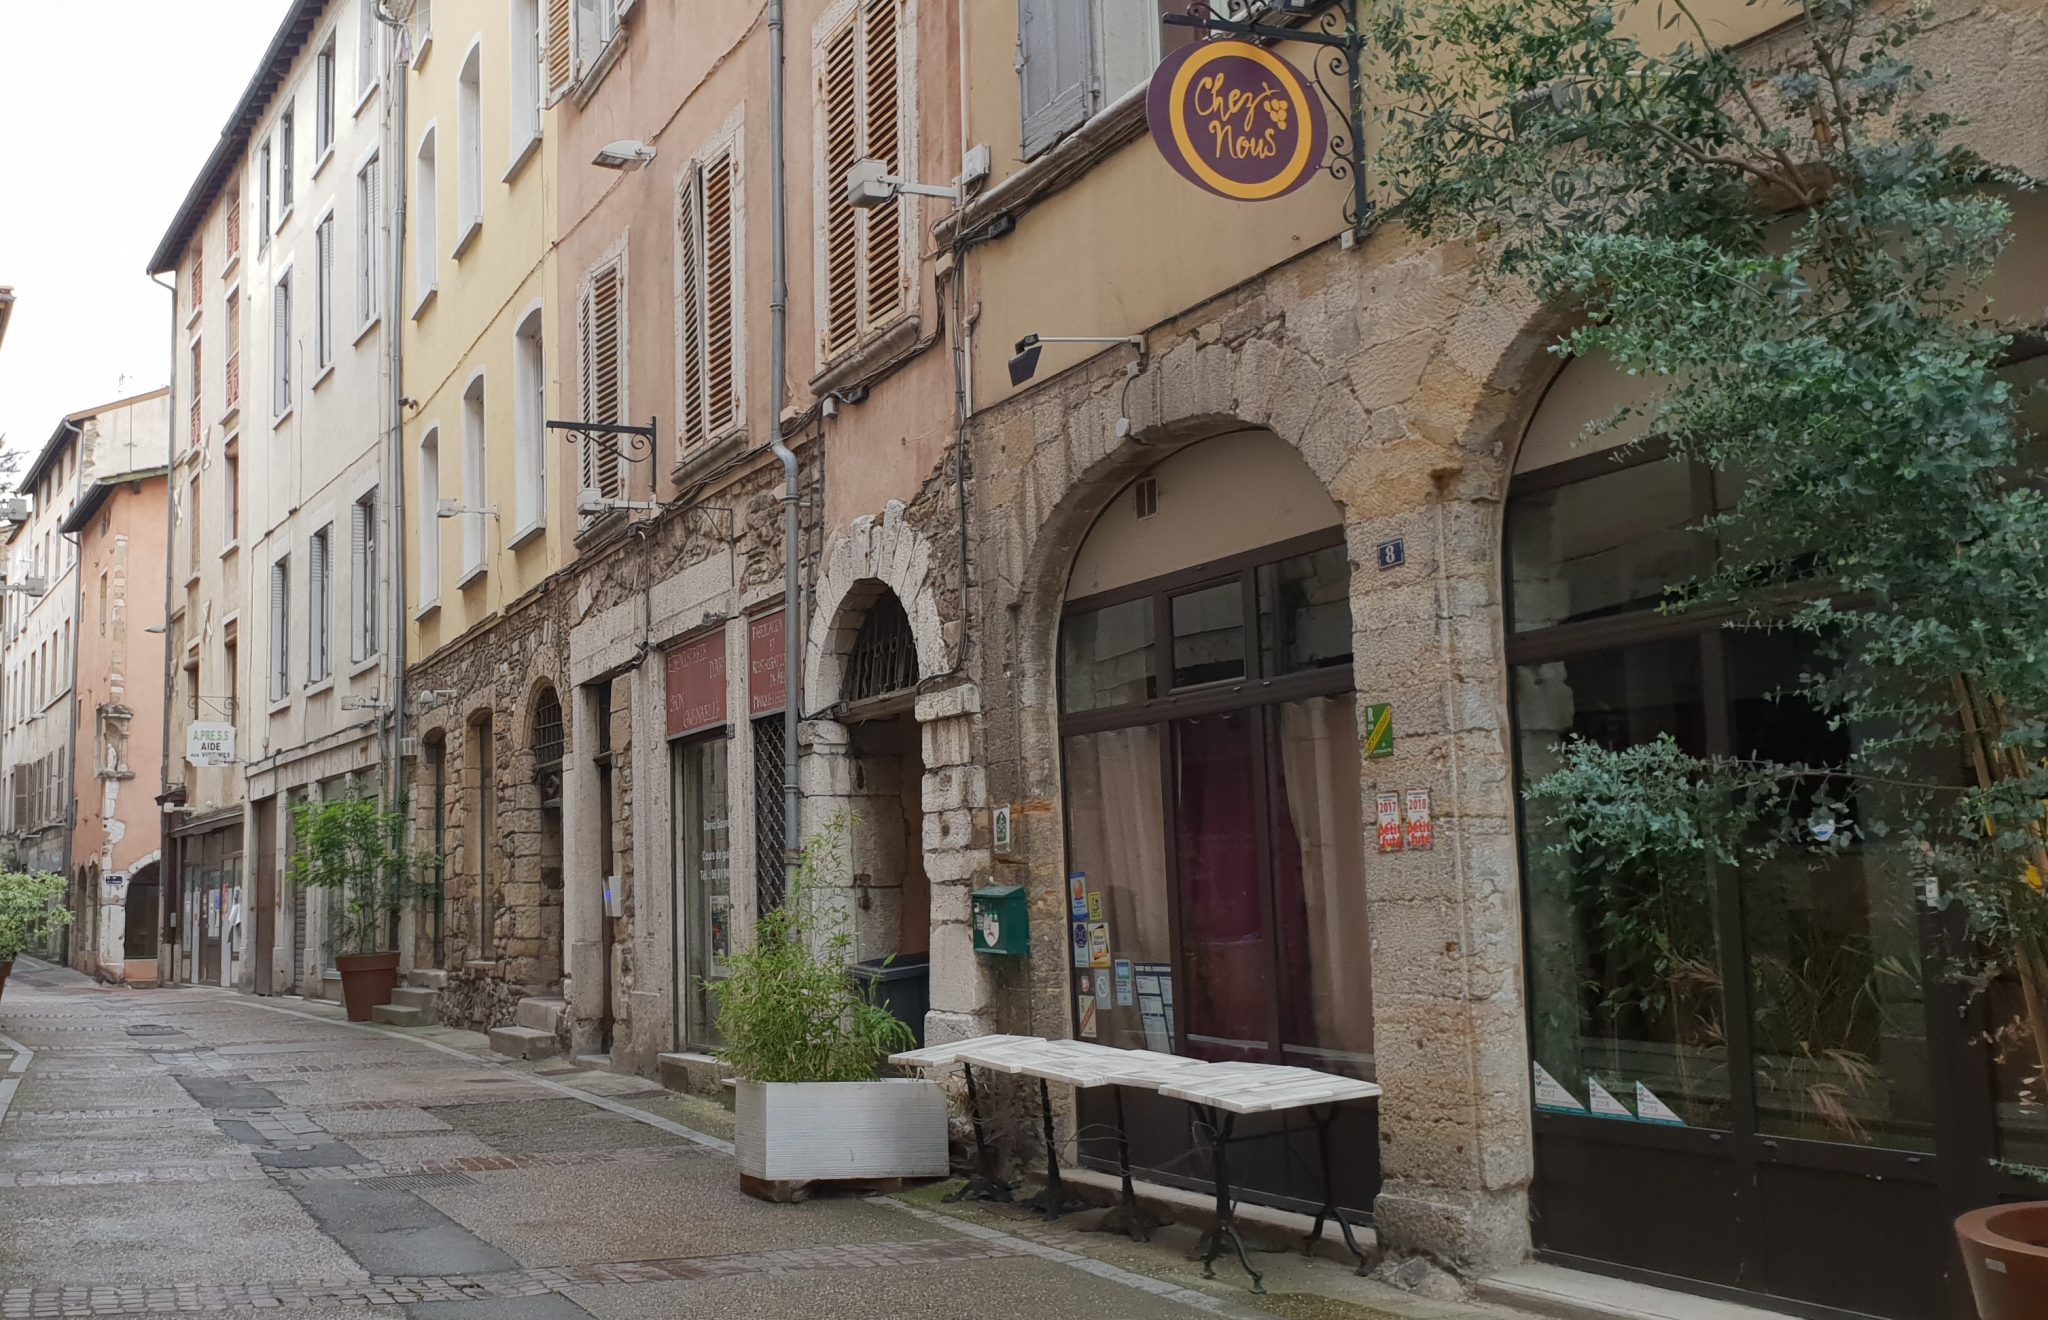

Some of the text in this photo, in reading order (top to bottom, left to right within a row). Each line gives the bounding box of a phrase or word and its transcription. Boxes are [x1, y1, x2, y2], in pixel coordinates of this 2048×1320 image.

[1194, 72, 1257, 132] Chez
[1208, 119, 1276, 160] Nous
[1384, 544, 1396, 563] 8
[201, 742, 221, 750] AIDE
[1379, 801, 1396, 813] 2017
[1409, 798, 1426, 810] 2018
[702, 849, 715, 861] Cours
[715, 848, 721, 860] de
